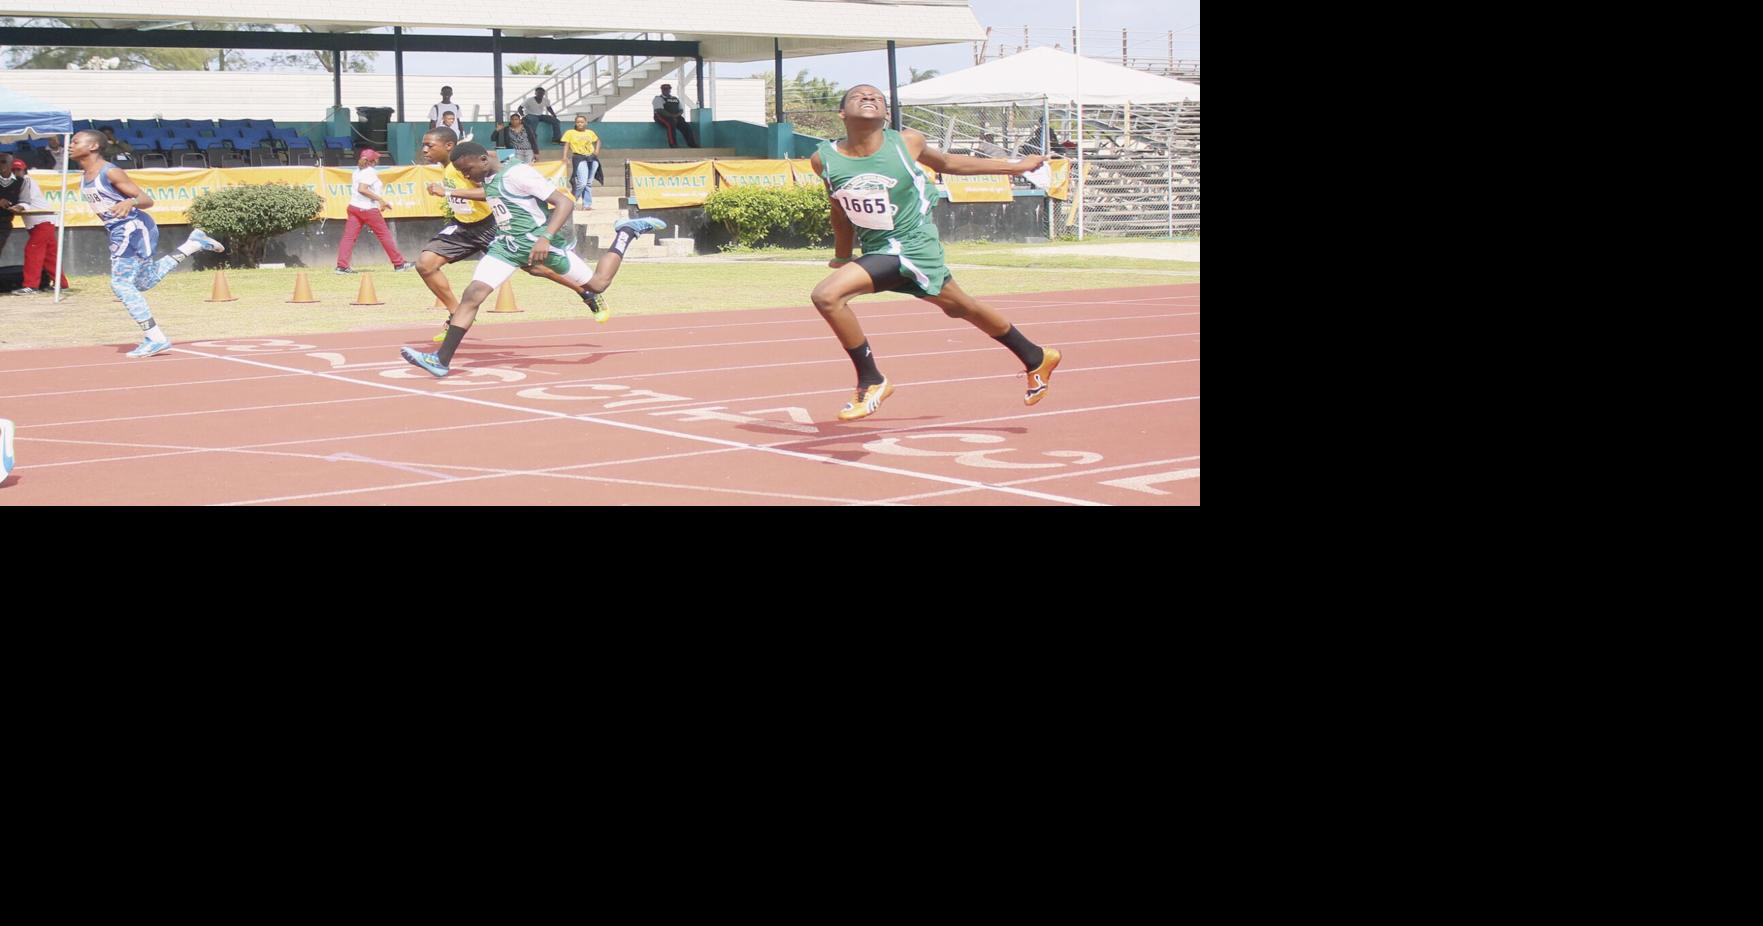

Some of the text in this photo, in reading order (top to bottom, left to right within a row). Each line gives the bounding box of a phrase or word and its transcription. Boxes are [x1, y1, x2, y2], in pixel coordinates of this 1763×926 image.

[328, 182, 416, 197] VITALT
[634, 175, 706, 188] VITAMALT
[842, 196, 887, 214] 1665
[862, 433, 1104, 469] 3
